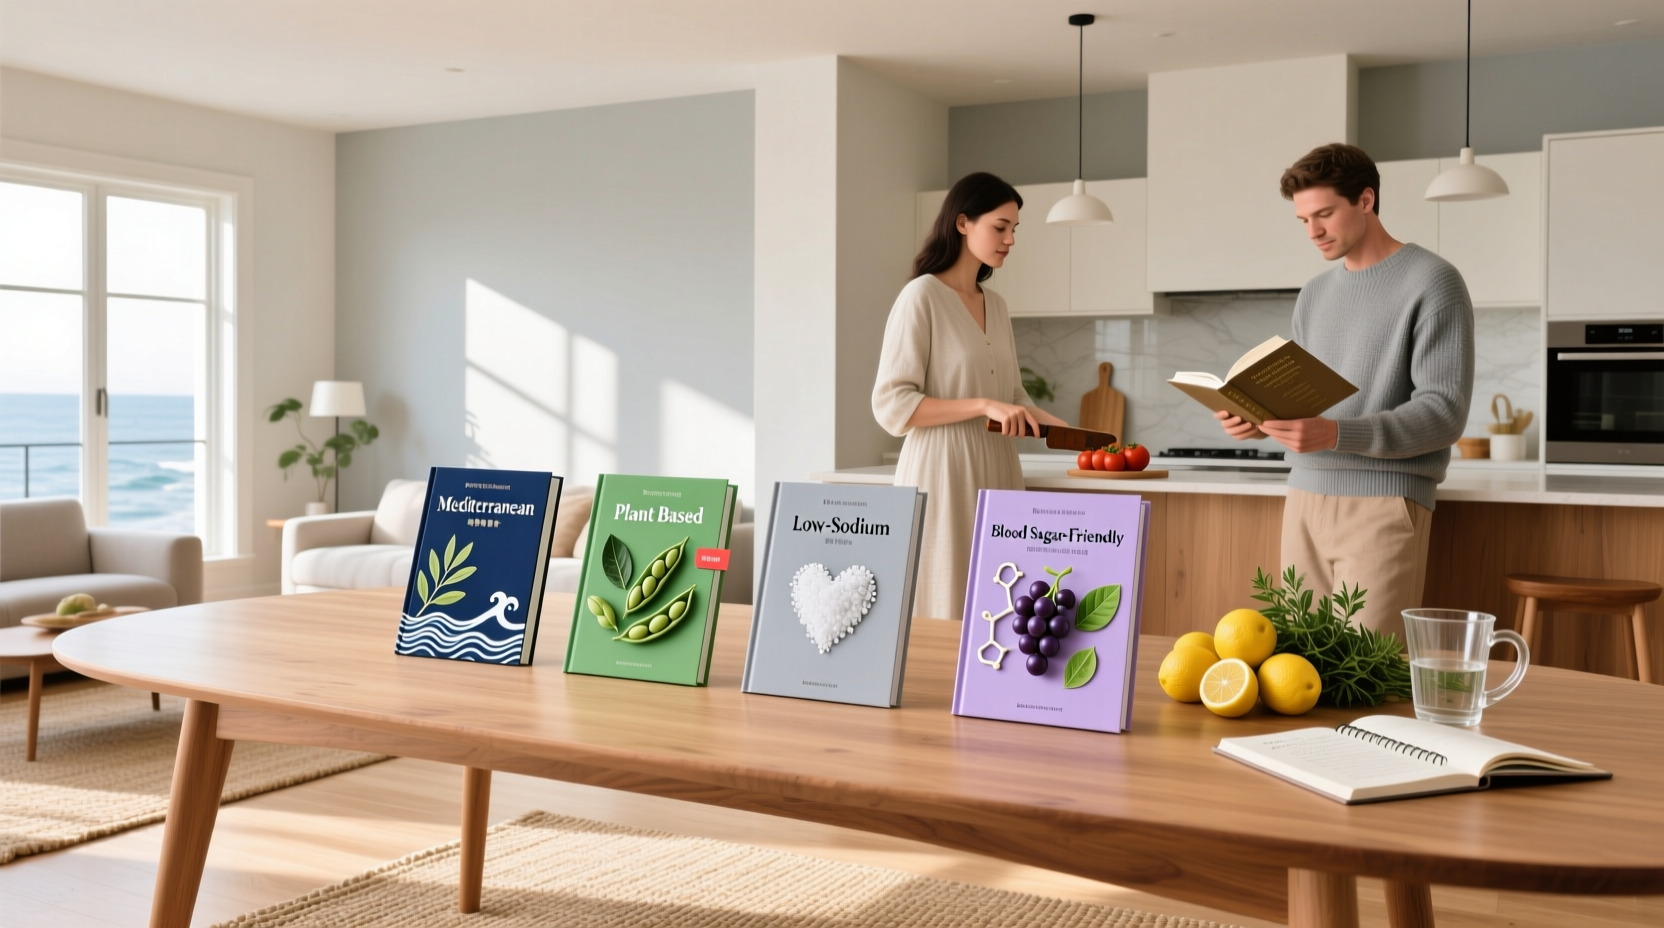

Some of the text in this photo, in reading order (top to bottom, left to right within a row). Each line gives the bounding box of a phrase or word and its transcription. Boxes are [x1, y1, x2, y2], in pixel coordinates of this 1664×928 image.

[614, 503, 704, 524] Plant Based
[793, 515, 890, 535] Low-Sodium
[991, 524, 1028, 540] Blood
